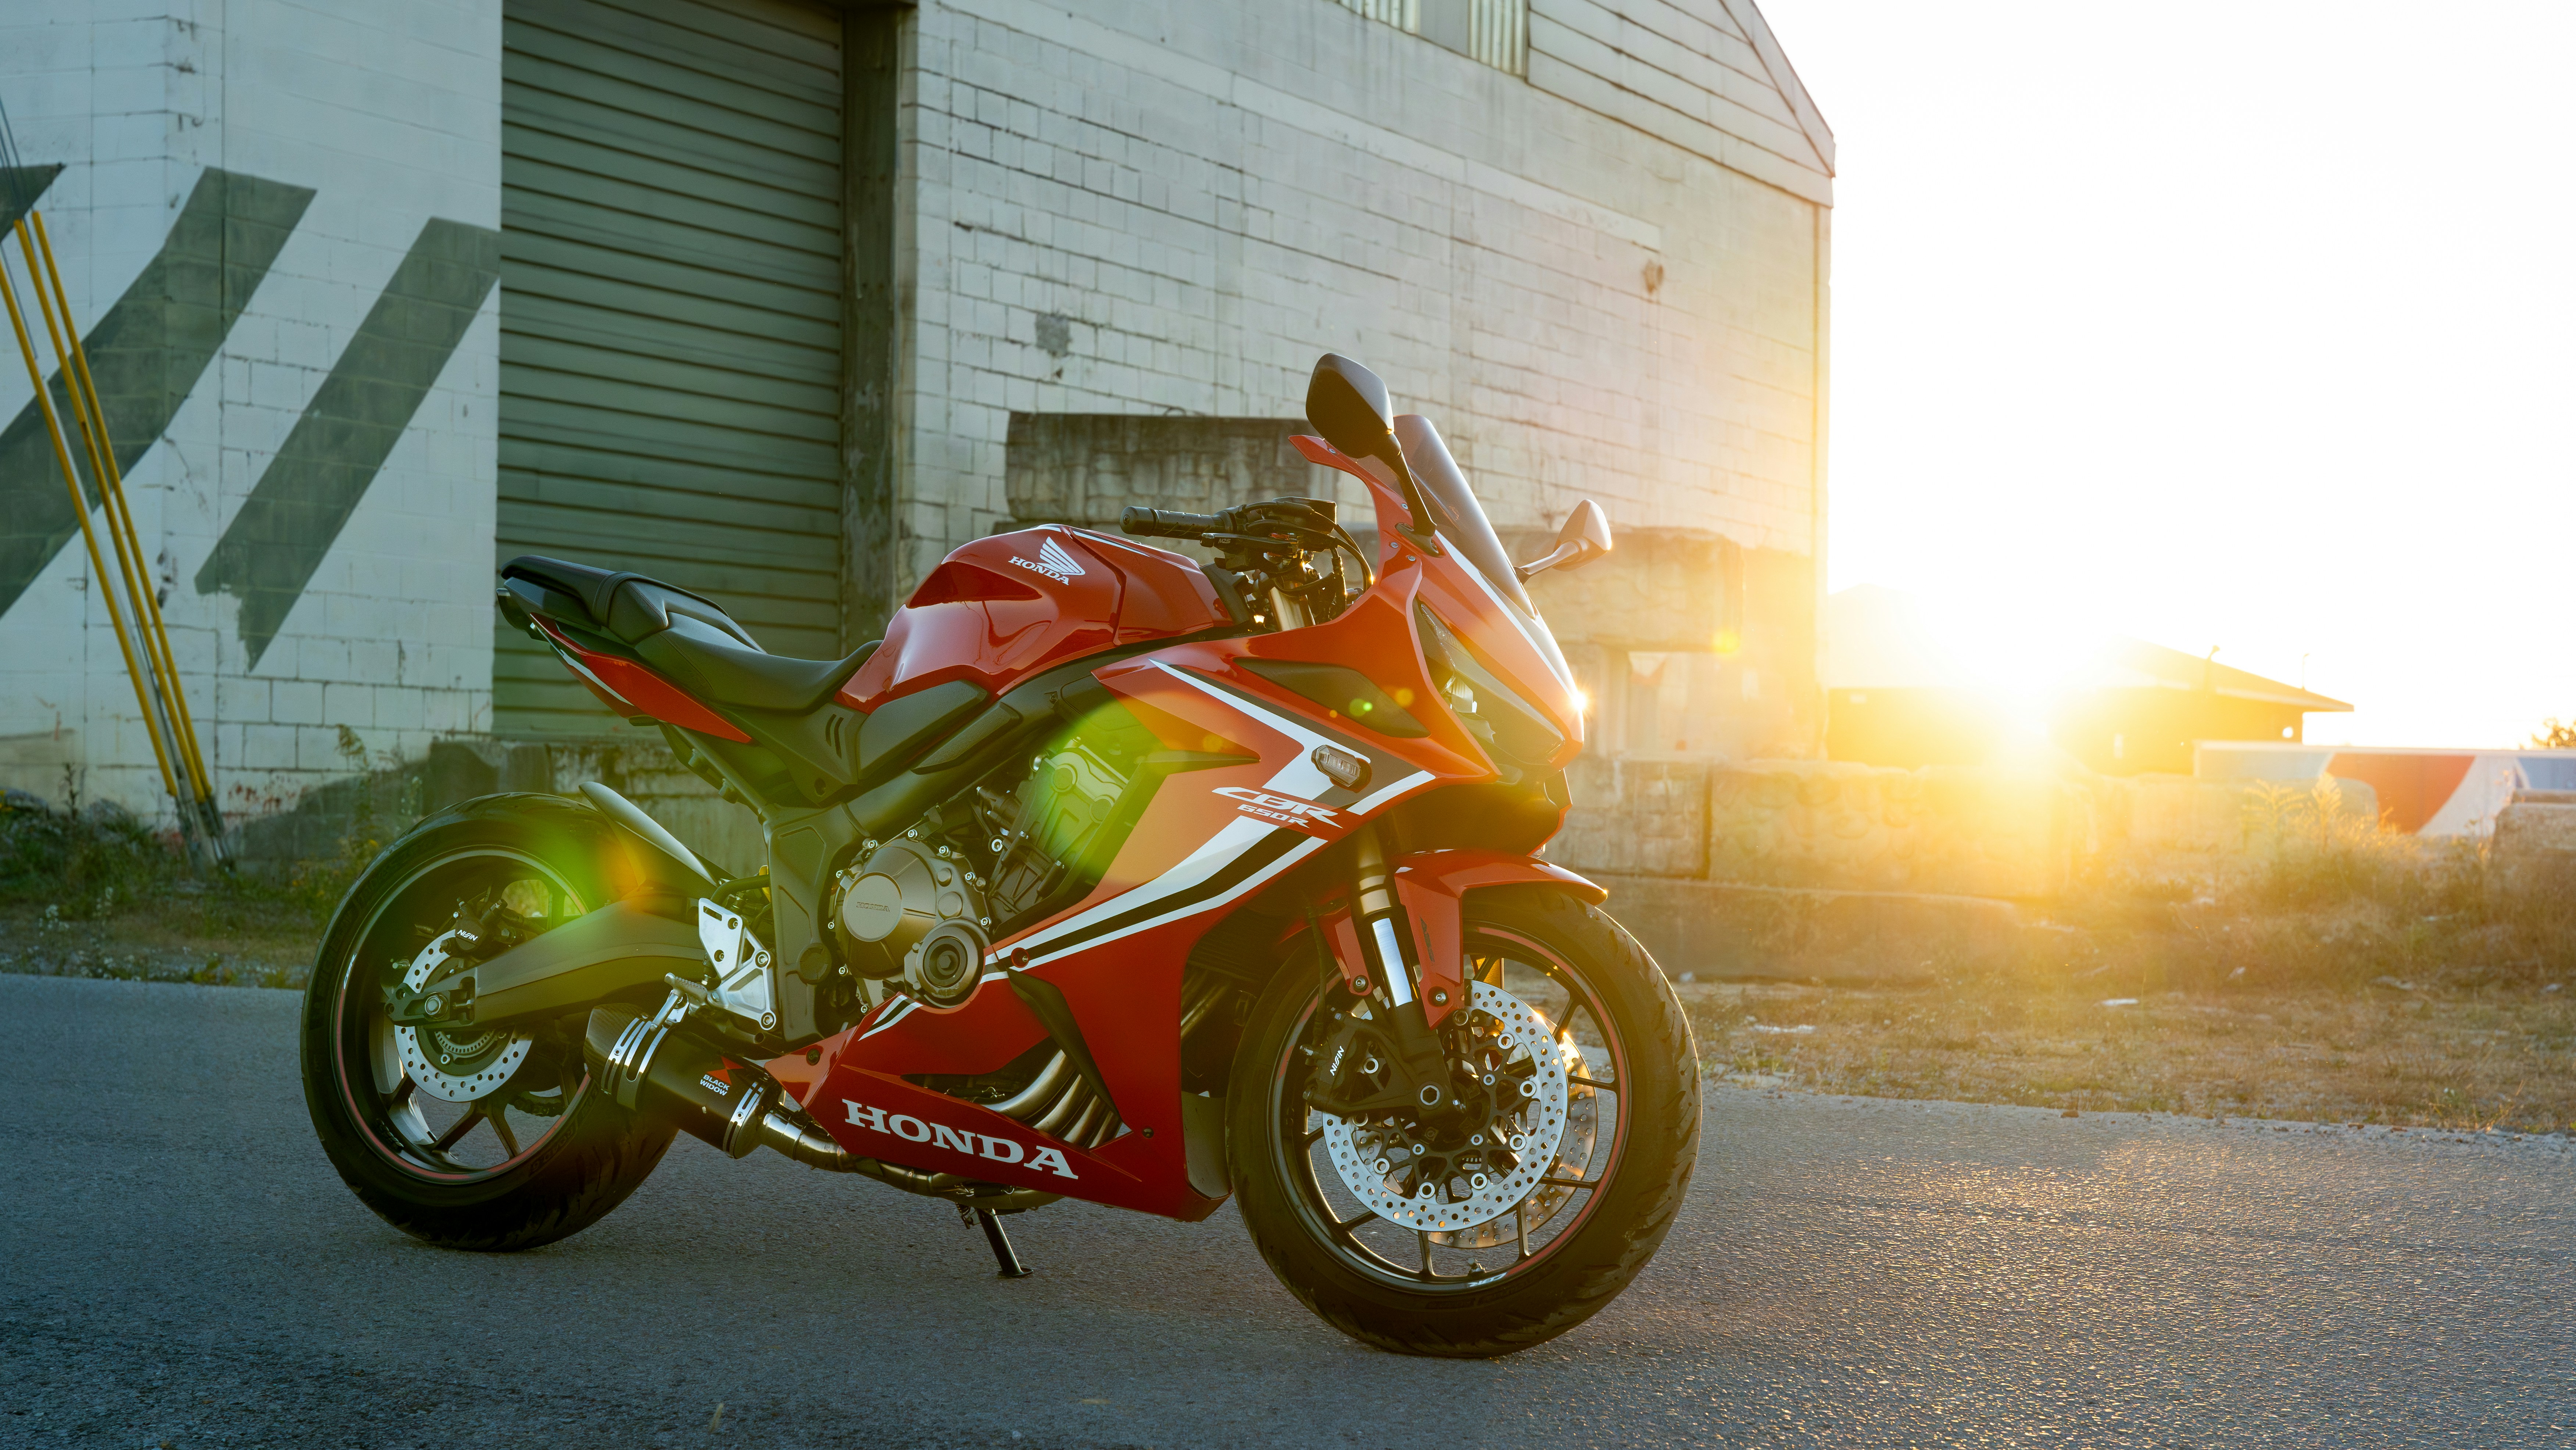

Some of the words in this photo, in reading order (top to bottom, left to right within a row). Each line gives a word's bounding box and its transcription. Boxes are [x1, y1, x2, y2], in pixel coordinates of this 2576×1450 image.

[1008, 556, 1069, 586] HONDA
[1212, 787, 1343, 829] CBR
[1237, 804, 1310, 829] 650R
[856, 902, 890, 912] HONDA
[343, 954, 357, 990] CBR
[700, 1079, 727, 1096] WIDOW
[703, 1074, 730, 1091] BLACK
[842, 1099, 1079, 1180] HONDA
[1467, 1272, 1508, 1288] CBR
